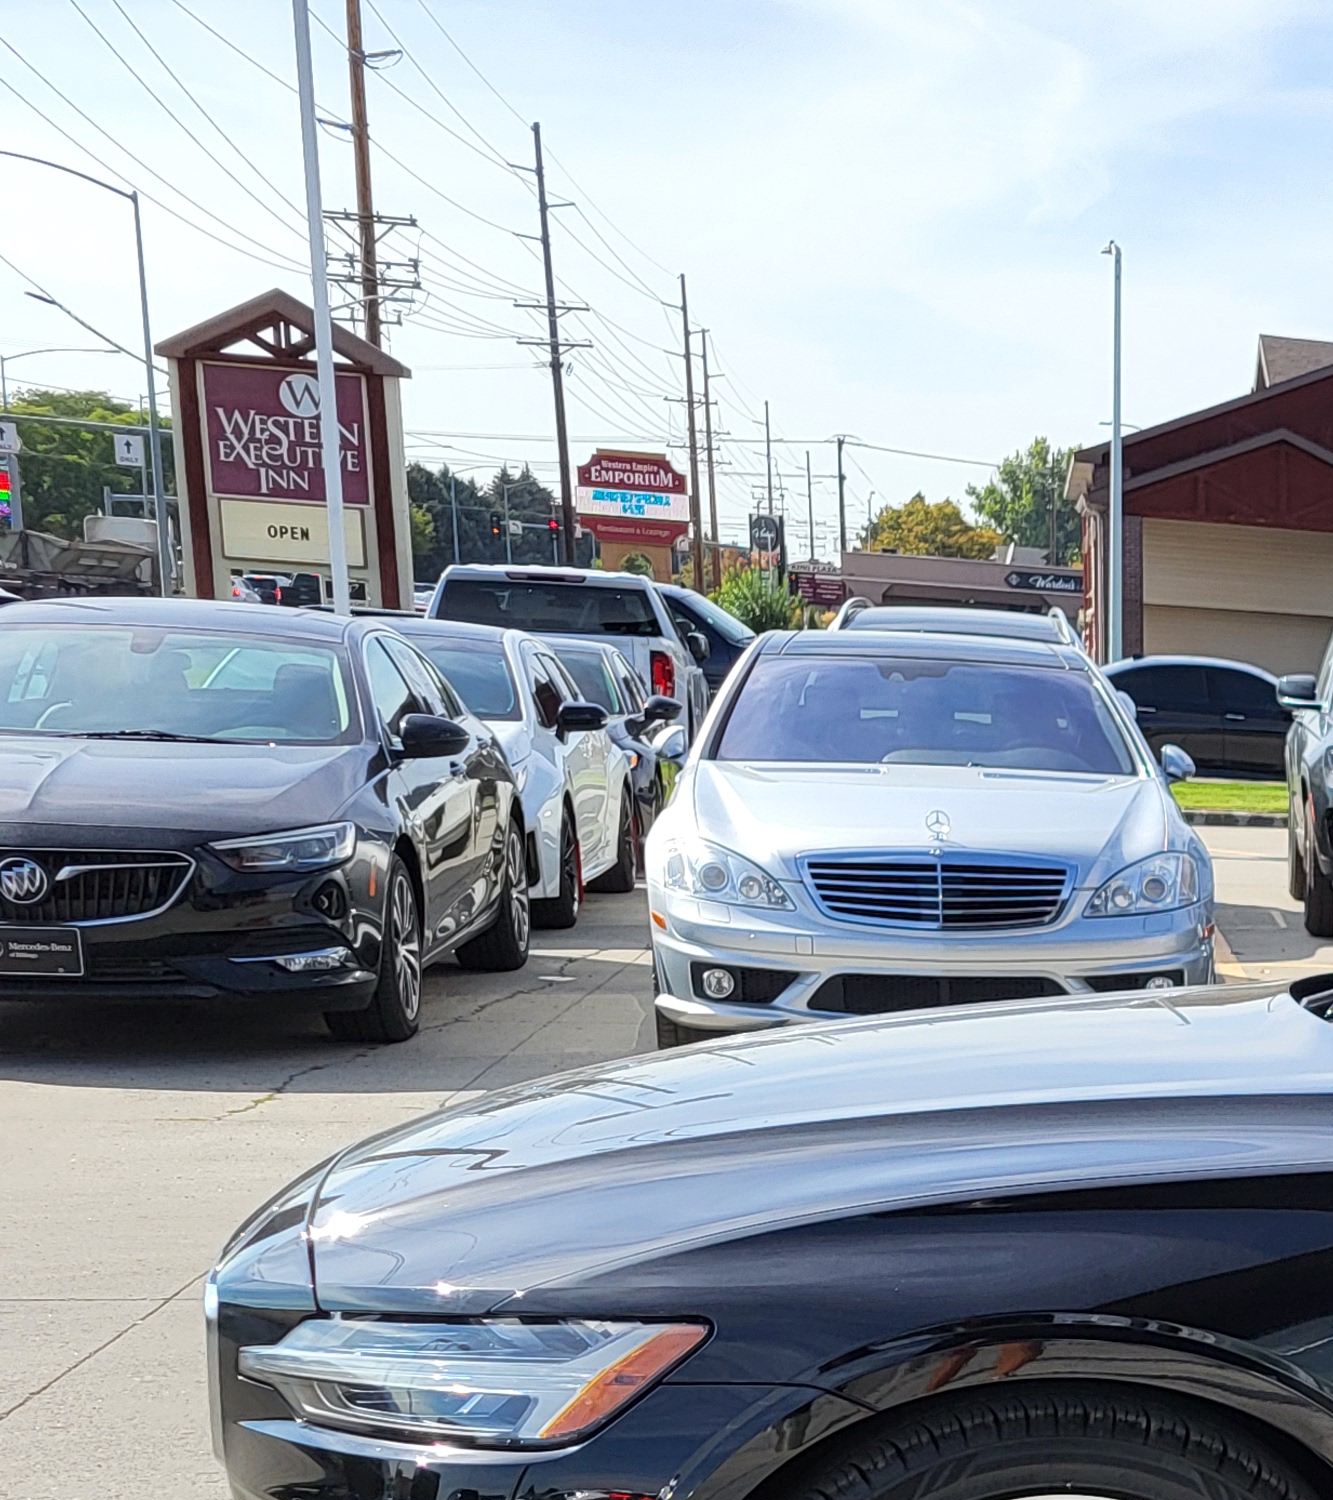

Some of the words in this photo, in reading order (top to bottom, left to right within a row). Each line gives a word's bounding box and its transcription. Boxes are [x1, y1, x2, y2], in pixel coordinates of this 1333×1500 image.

[214, 406, 360, 453] WESTEN
[217, 434, 361, 473] EXECUTE
[590, 465, 673, 488] EMPORIUM
[601, 460, 631, 470] Western
[632, 462, 658, 472] Empire
[259, 467, 309, 494] INN
[267, 524, 310, 541] OPEN
[8, 942, 72, 951] Mercedes-Benz
